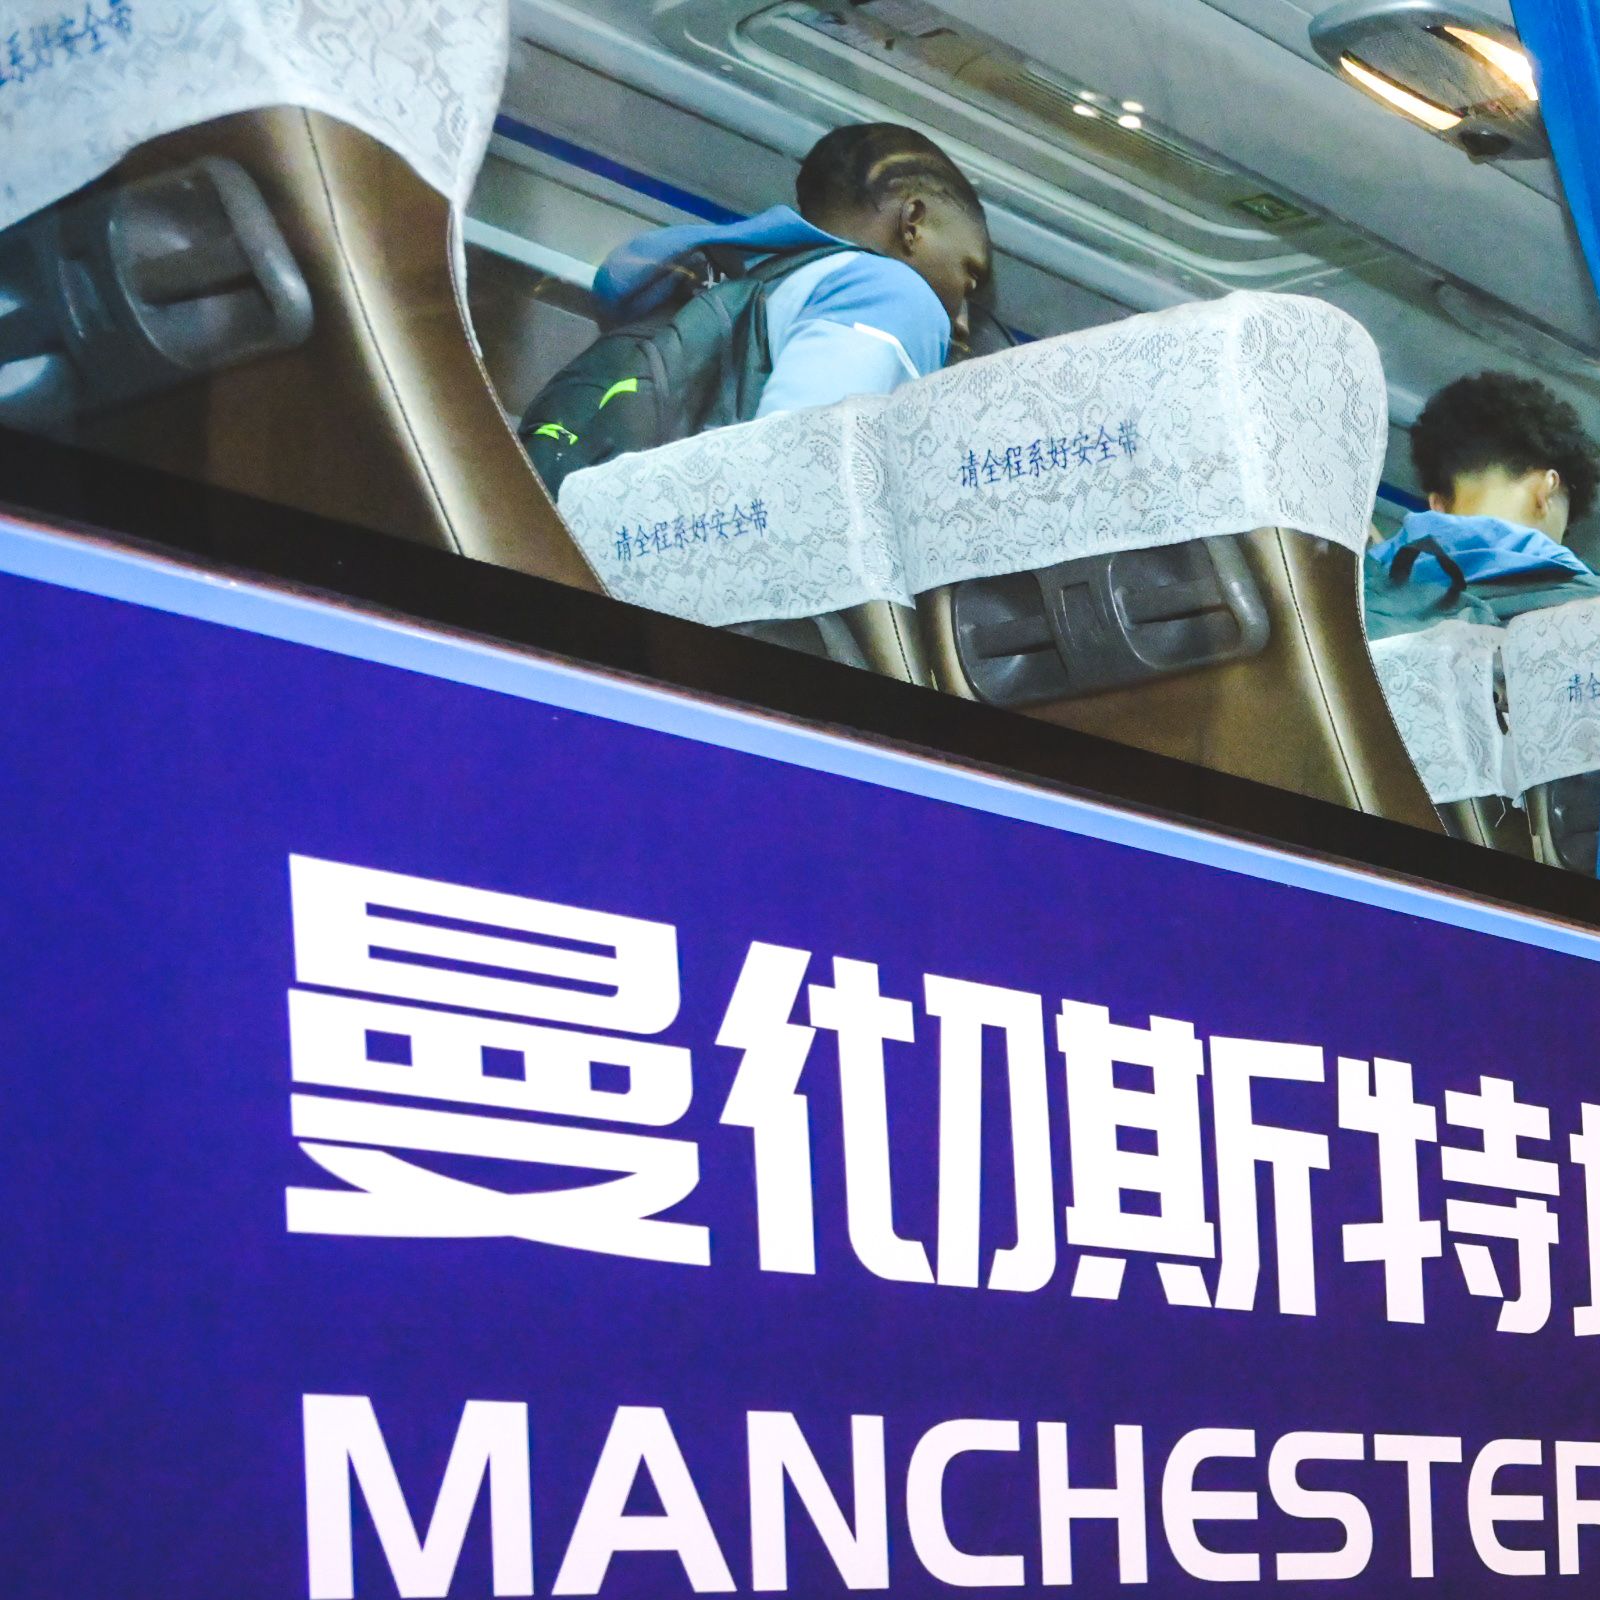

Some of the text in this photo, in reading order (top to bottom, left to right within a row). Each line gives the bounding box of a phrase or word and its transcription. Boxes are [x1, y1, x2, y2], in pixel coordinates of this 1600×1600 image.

[957, 419, 1138, 488] 请全程系好安全带
[614, 498, 768, 561] 请全程系好安全带
